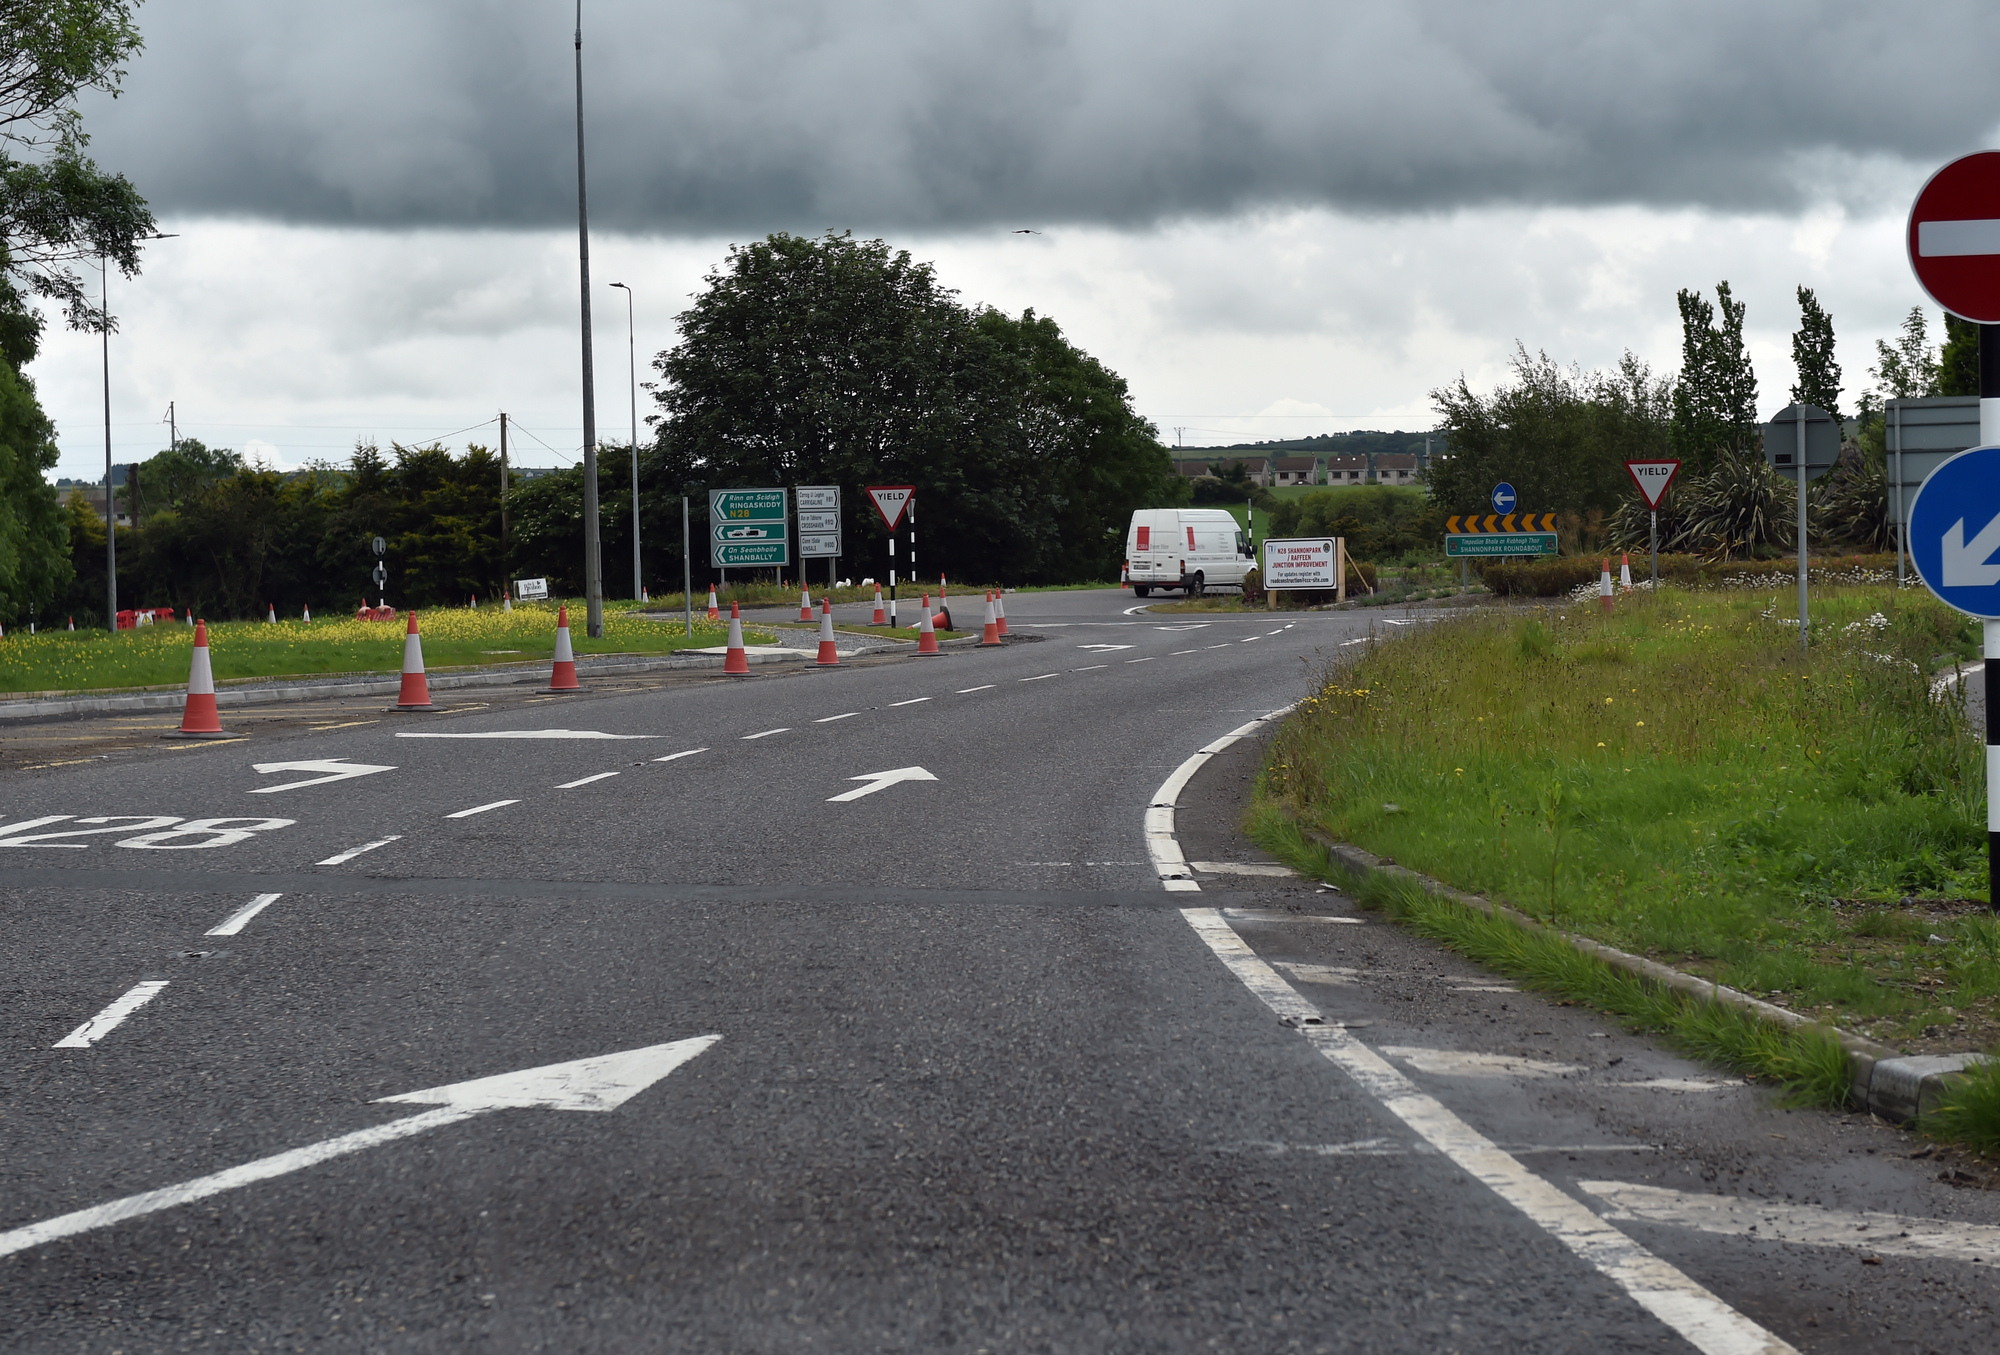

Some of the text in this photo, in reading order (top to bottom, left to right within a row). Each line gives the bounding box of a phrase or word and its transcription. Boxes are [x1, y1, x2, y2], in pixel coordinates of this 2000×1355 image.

[1637, 467, 1668, 476] YIELD
[878, 492, 905, 500] YIELD
[730, 509, 750, 518] N28
[1503, 544, 1542, 552] ROUNDABOUT
[728, 554, 773, 562] SHANBALLY
